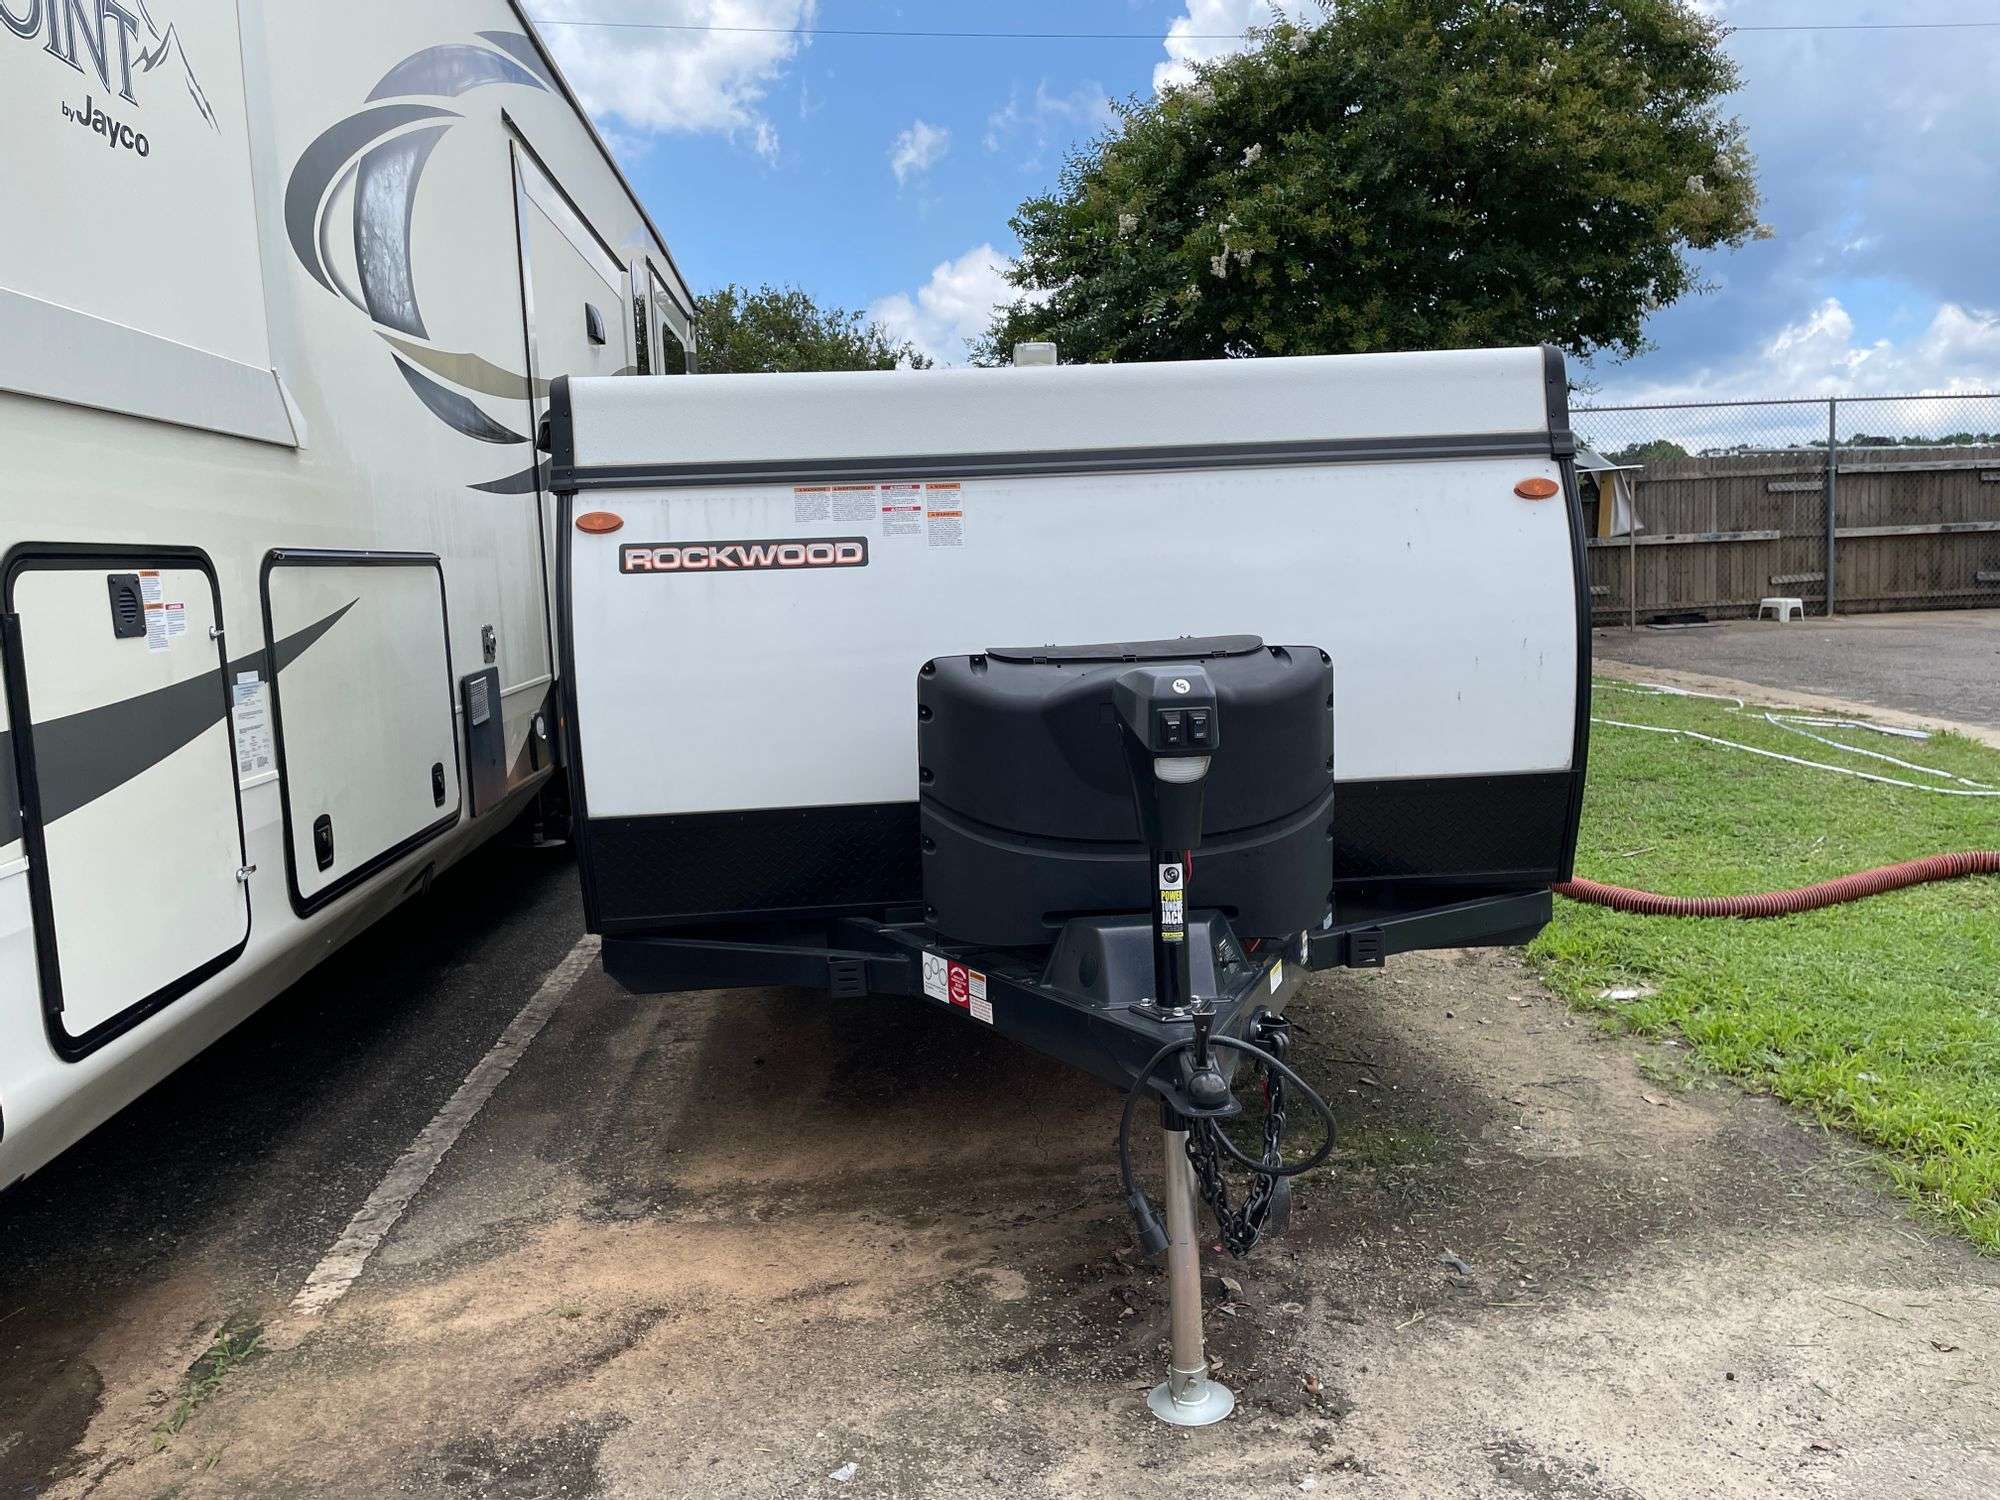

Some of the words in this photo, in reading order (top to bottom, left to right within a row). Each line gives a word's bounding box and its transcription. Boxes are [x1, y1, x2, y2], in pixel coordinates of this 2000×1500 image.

[61, 101, 75, 122] by
[76, 95, 149, 157] Jayco
[625, 543, 863, 570] ROCKWOOD
[1161, 890, 1183, 901] POWER
[1162, 911, 1184, 925] JACK
